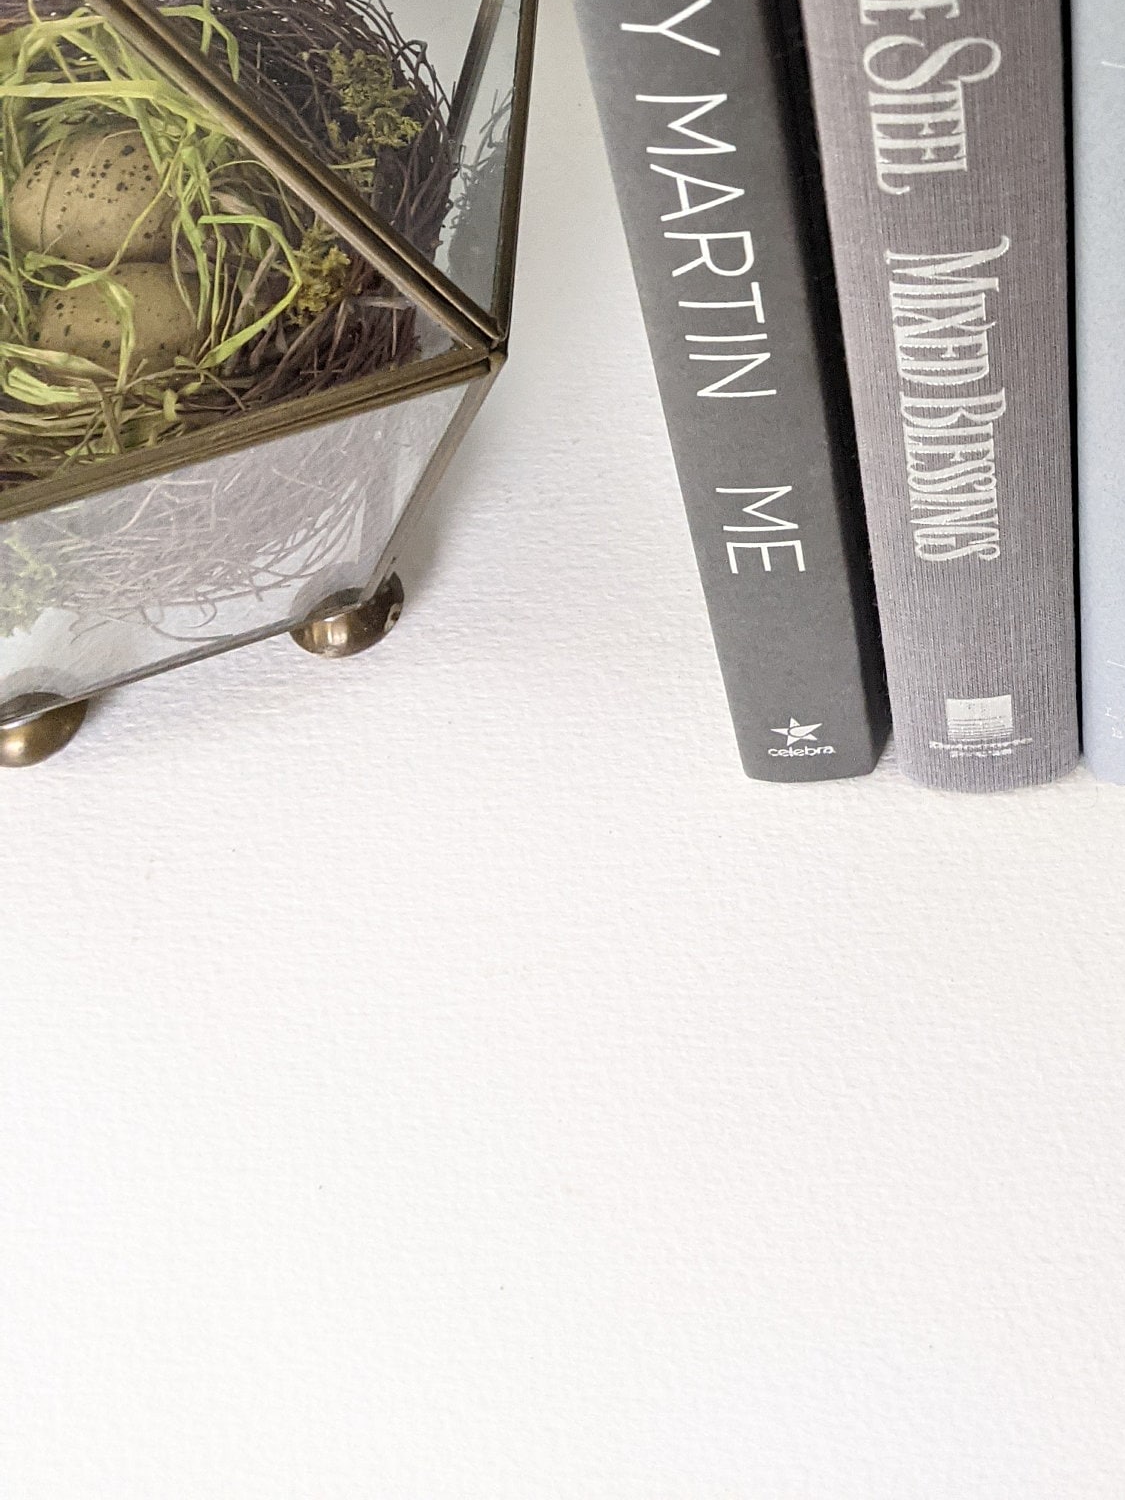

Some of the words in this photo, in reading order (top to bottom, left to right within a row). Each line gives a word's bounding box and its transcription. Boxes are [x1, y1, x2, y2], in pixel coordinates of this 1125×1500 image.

[861, 33, 1002, 196] STEEL
[632, 92, 778, 400] MARTIN
[714, 484, 806, 576] ME
[884, 235, 1010, 387] MIXED
[900, 387, 1006, 563] BLESSINGS
[768, 745, 836, 757] celebra
